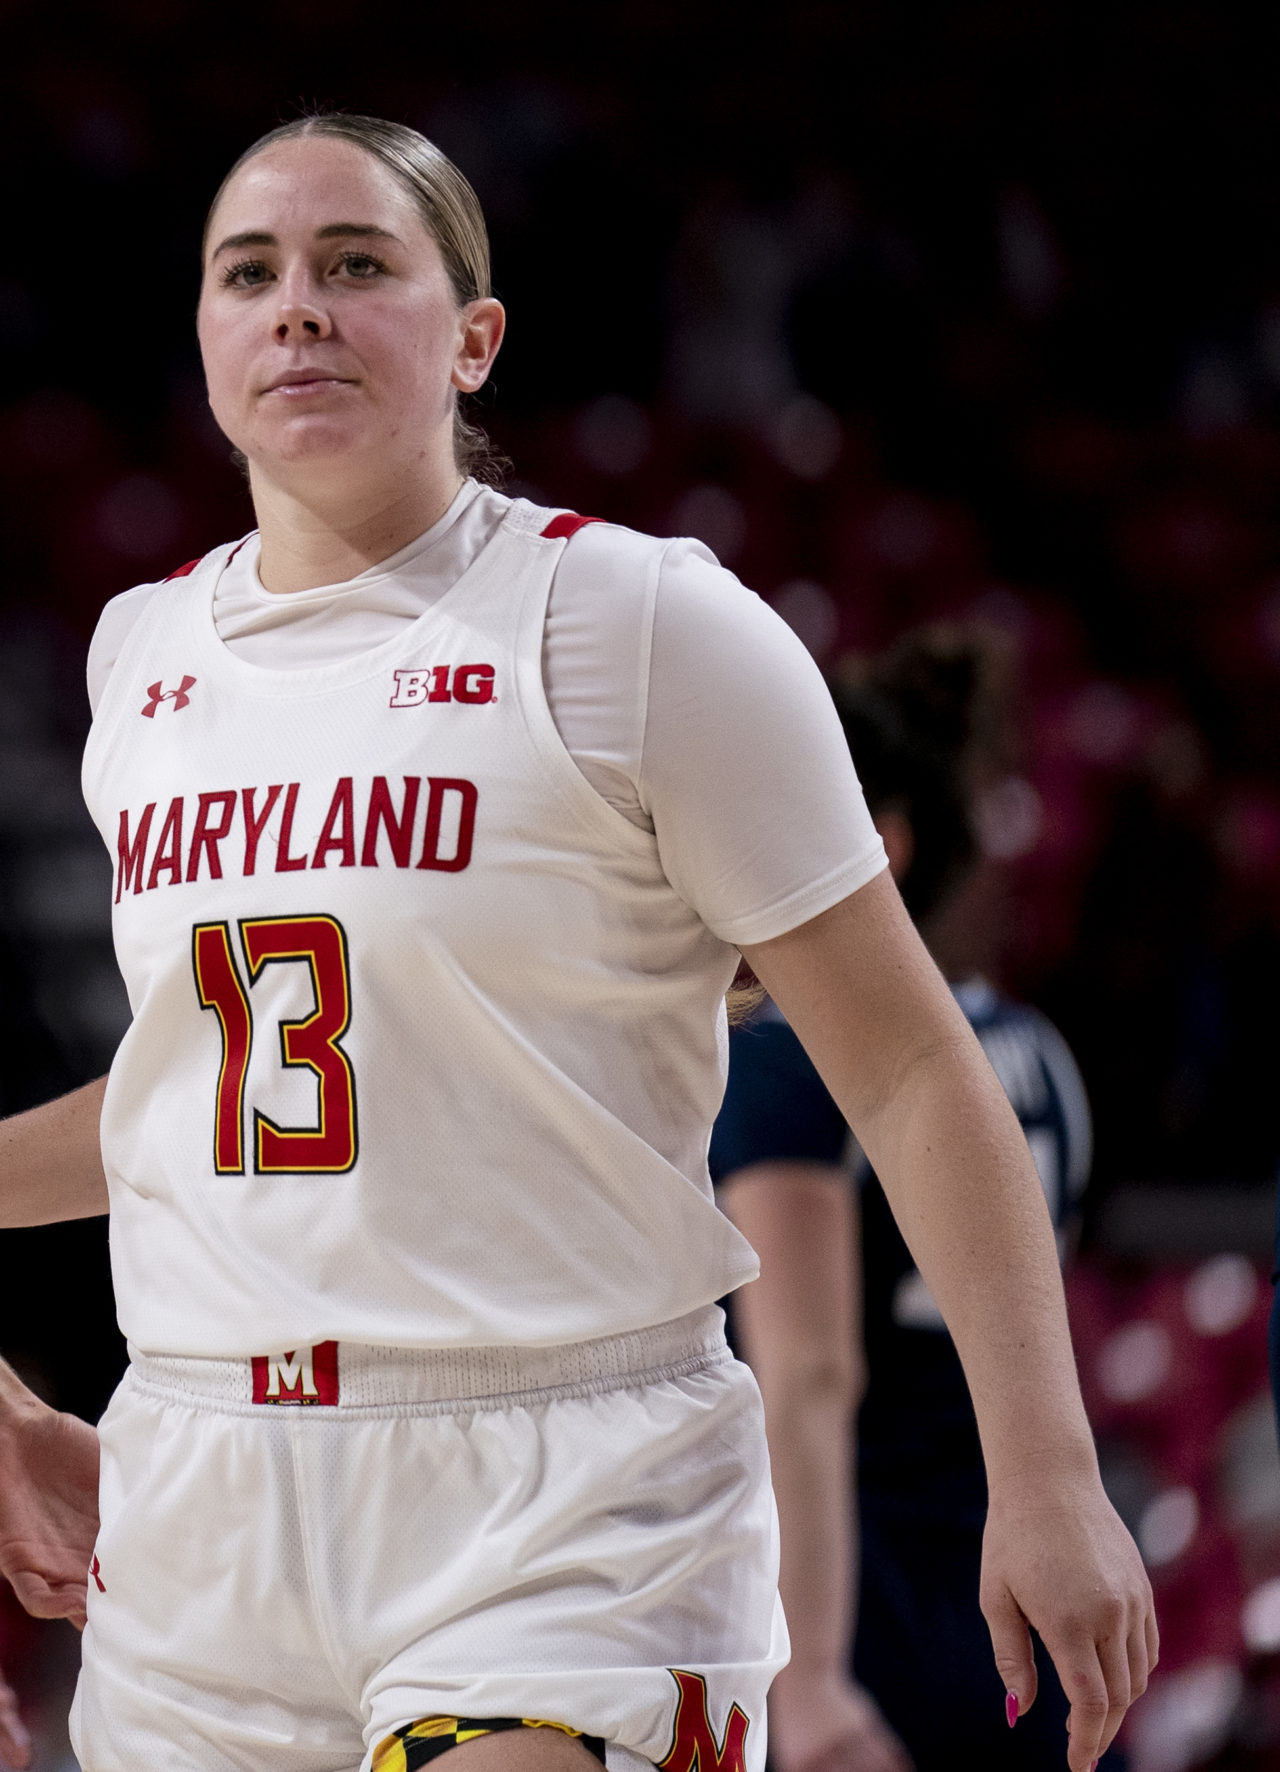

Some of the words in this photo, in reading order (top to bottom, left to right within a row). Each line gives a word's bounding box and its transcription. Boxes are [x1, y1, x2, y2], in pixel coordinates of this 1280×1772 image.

[114, 775, 479, 905] MARYLAND
[191, 912, 360, 1177] 13
[263, 1346, 321, 1397] M
